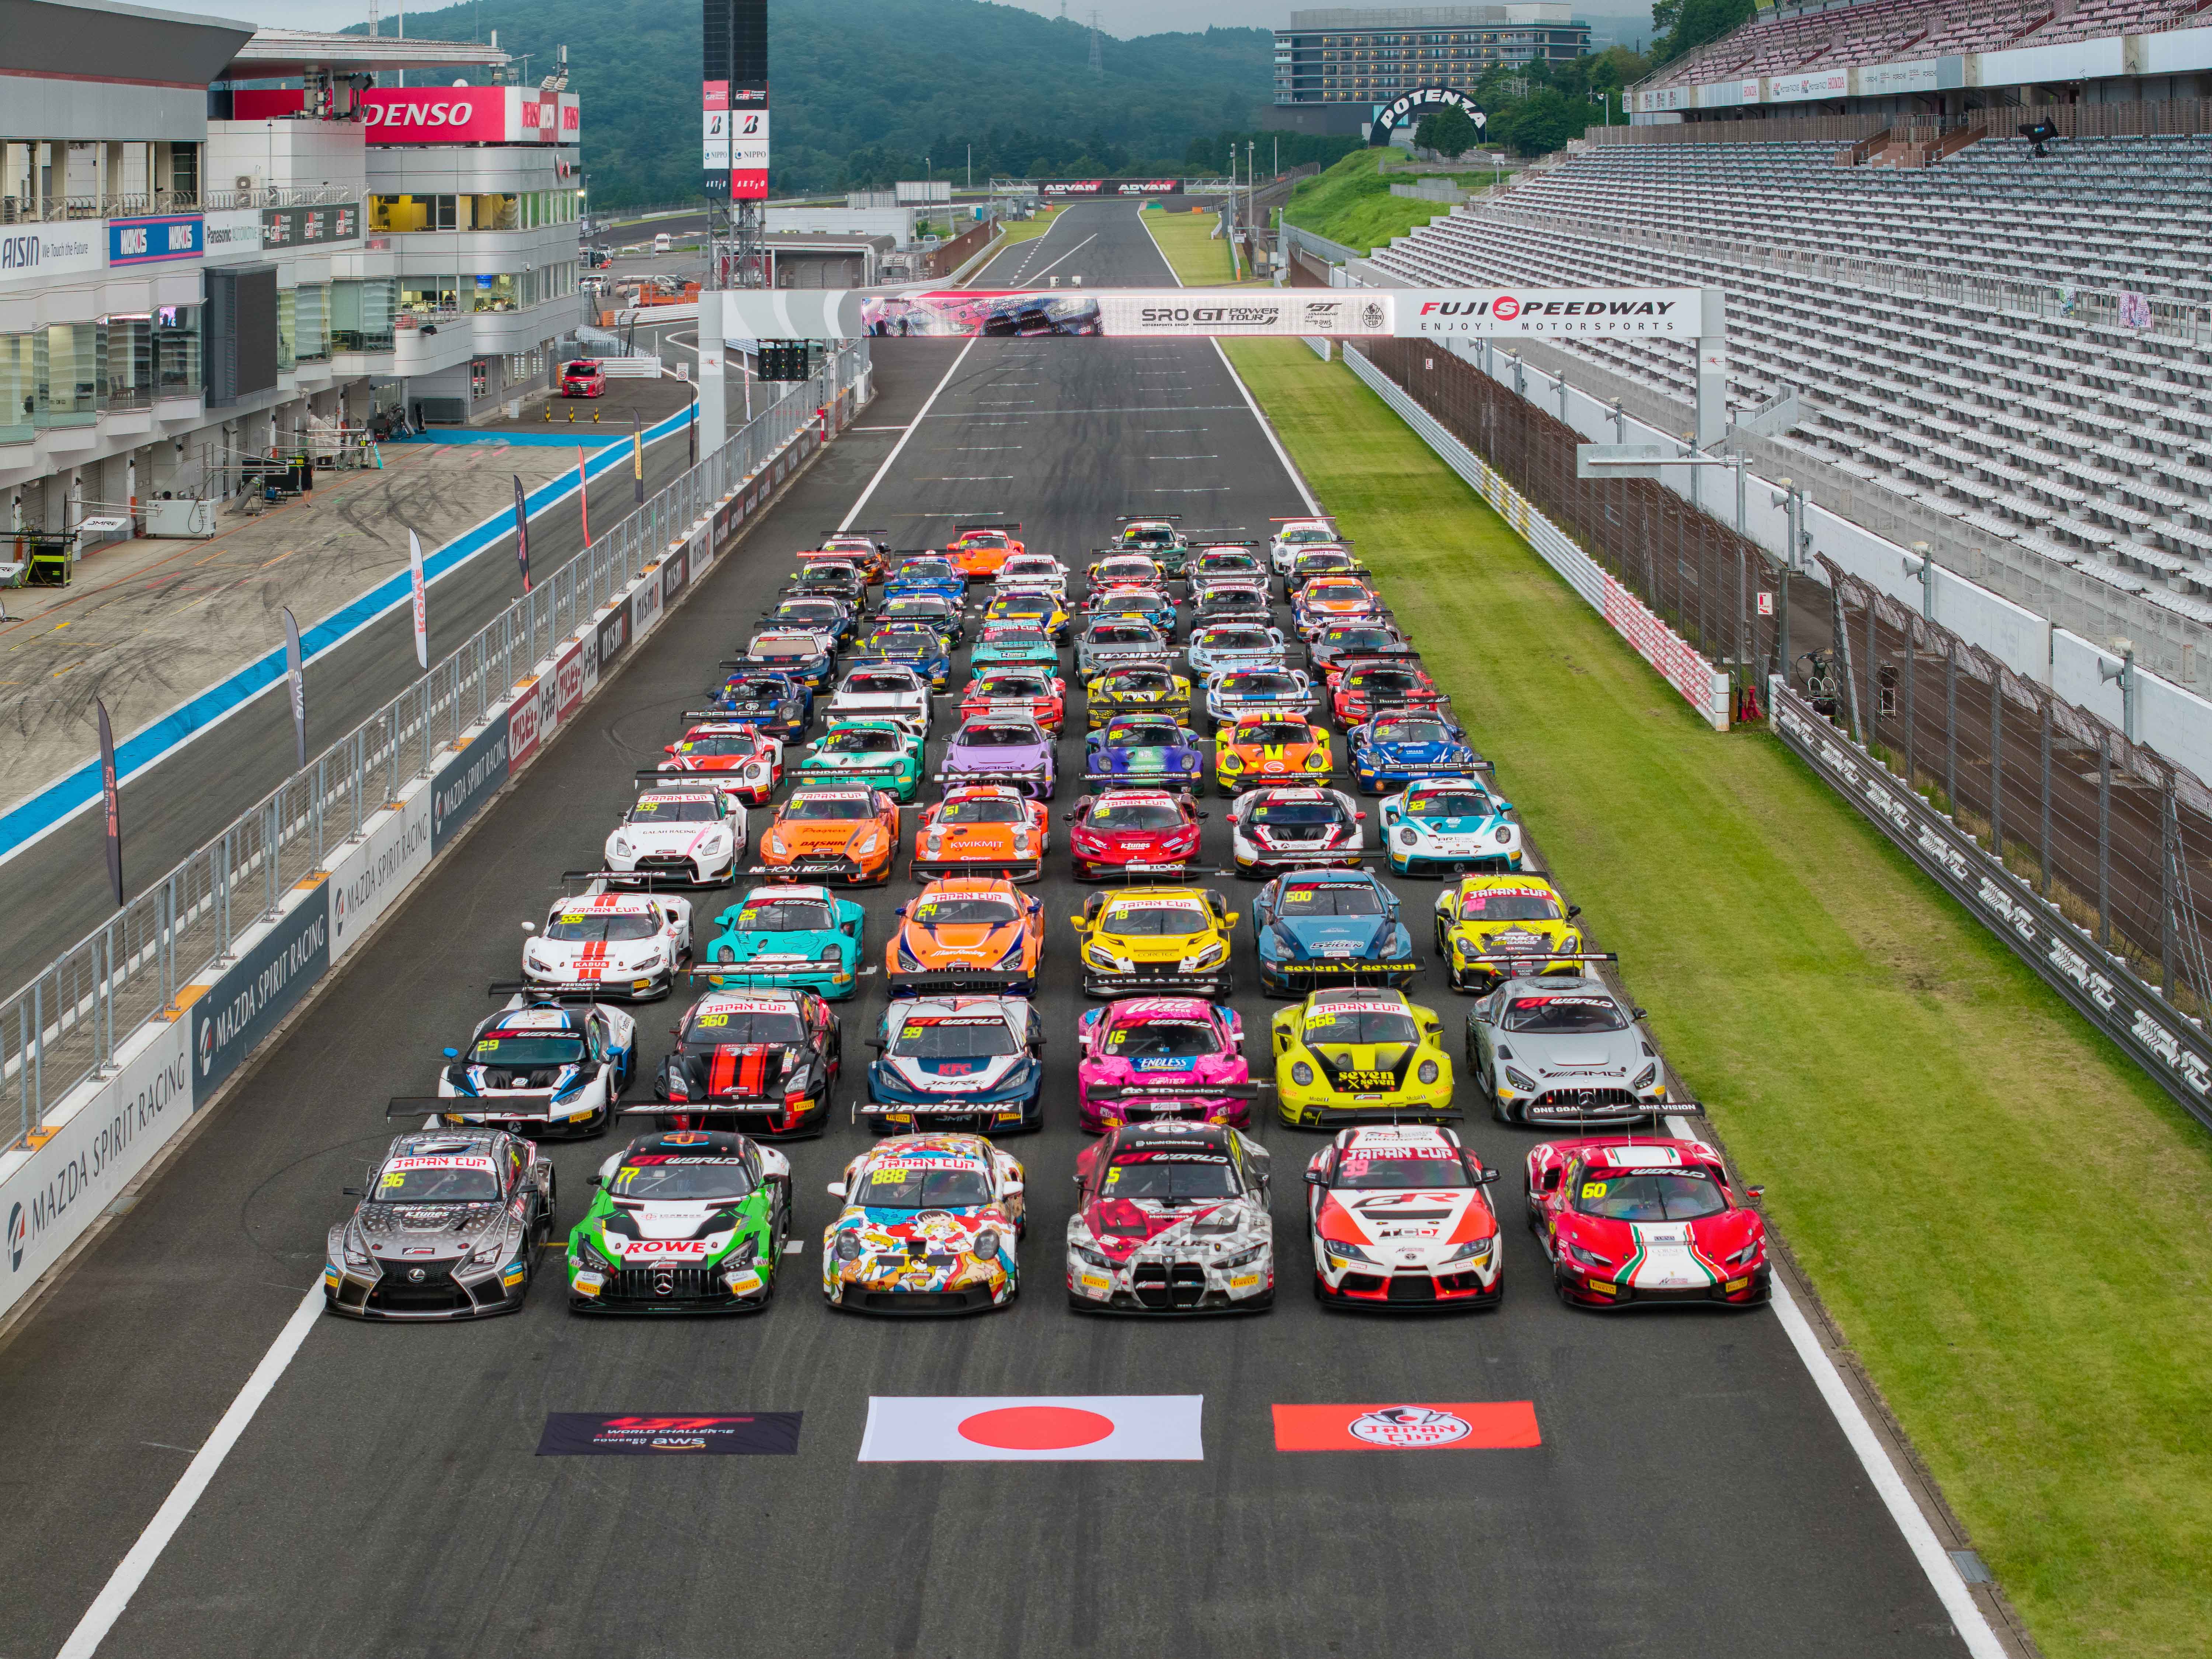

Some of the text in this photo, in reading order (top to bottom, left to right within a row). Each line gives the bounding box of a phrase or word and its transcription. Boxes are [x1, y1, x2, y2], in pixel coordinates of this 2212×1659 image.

[1827, 76, 1844, 90] HONDA
[1743, 86, 1757, 97] HONDA
[365, 103, 472, 126] DENSO
[1380, 88, 1486, 129] POTENZA
[207, 225, 231, 244] Panasonic
[2, 236, 39, 269] AISIN
[42, 244, 49, 257] We
[51, 242, 64, 256] Touch
[74, 241, 88, 254] Future
[1142, 308, 1189, 321] SRO
[1193, 308, 1229, 321] GT
[1420, 301, 1676, 317] FUJI SPEEDWAY
[1421, 323, 1674, 331] ENJOY! MOTORSPORTS
[1350, 677, 1363, 685] 46
[1109, 730, 1123, 740] 86
[1237, 729, 1251, 738] 37
[1376, 727, 1390, 736] 33
[827, 735, 842, 744] 87
[444, 735, 506, 819] MAZDA SPIRIT RACING
[636, 803, 659, 811] 935
[1095, 808, 1110, 819] 98
[347, 813, 427, 919] MAZDA SPIRIT RACING
[1286, 891, 1312, 902] 500
[738, 909, 758, 921] 25
[919, 904, 938, 917] 24
[1116, 910, 1128, 920] 18
[559, 914, 585, 924] 555
[216, 914, 324, 1052] MAZDA SPIRIT RACING
[1550, 998, 1613, 1008] WORLD
[698, 1015, 728, 1028] 360
[1305, 1013, 1336, 1030] 666
[902, 1027, 923, 1039] 99
[1108, 1030, 1127, 1044] 16
[477, 1039, 500, 1052] 29
[1141, 1057, 1187, 1068] ENDLESS
[938, 1064, 971, 1075] KFC
[1338, 1071, 1395, 1081] seven
[860, 1104, 1015, 1112] SUPERLINK
[33, 1052, 184, 1239] MAZDA SPIRIT RACING
[1347, 1148, 1453, 1159] JAPAN CUP
[394, 1158, 486, 1168] JAPAN CUP
[878, 1158, 974, 1170] JAPAN CUP
[1343, 1161, 1368, 1177] 39
[618, 1167, 640, 1183] 77
[872, 1169, 908, 1185] 888
[1106, 1167, 1121, 1183] 5
[1630, 1168, 1705, 1178] WORLD
[382, 1173, 406, 1187] 96
[1582, 1182, 1607, 1199] 60
[1351, 1193, 1460, 1208] GR
[625, 1242, 706, 1254] ROWE
[1364, 1425, 1457, 1434] JAPAN
